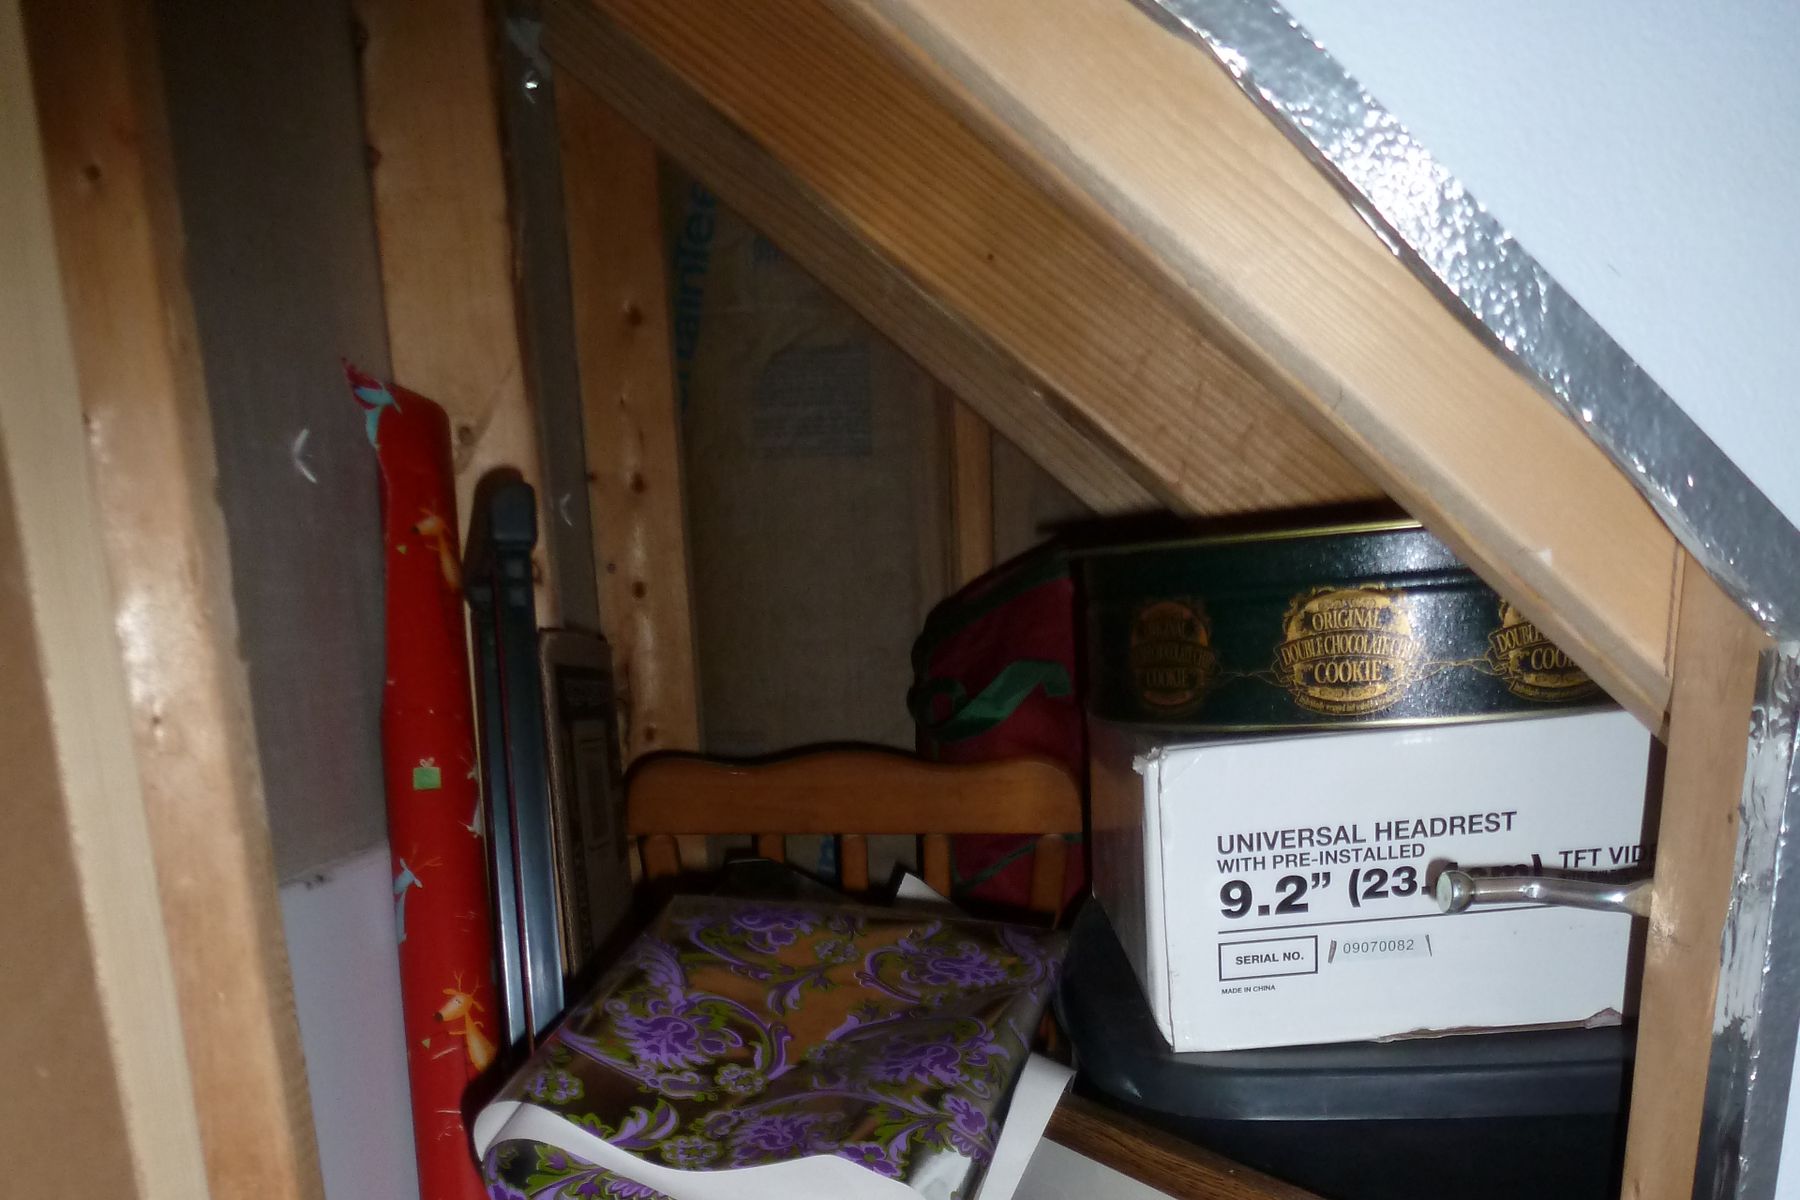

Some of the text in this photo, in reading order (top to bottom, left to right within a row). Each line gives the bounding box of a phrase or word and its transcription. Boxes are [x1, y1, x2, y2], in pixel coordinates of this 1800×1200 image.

[1312, 609, 1382, 631] ORIGINAL
[1281, 636, 1323, 665] DOUBLE
[1324, 632, 1388, 657] CHOCOLATE
[1314, 659, 1382, 684] COOKIE
[1216, 811, 1518, 855] UNIVERSAL HEADREST
[1217, 842, 1426, 875] WITH PRE-INSTALLED
[1559, 847, 1603, 870] TFT
[1235, 949, 1305, 966] SERIAL NO.
[1342, 938, 1415, 955] 09070082
[1221, 984, 1276, 996] MADE IN CHINA
